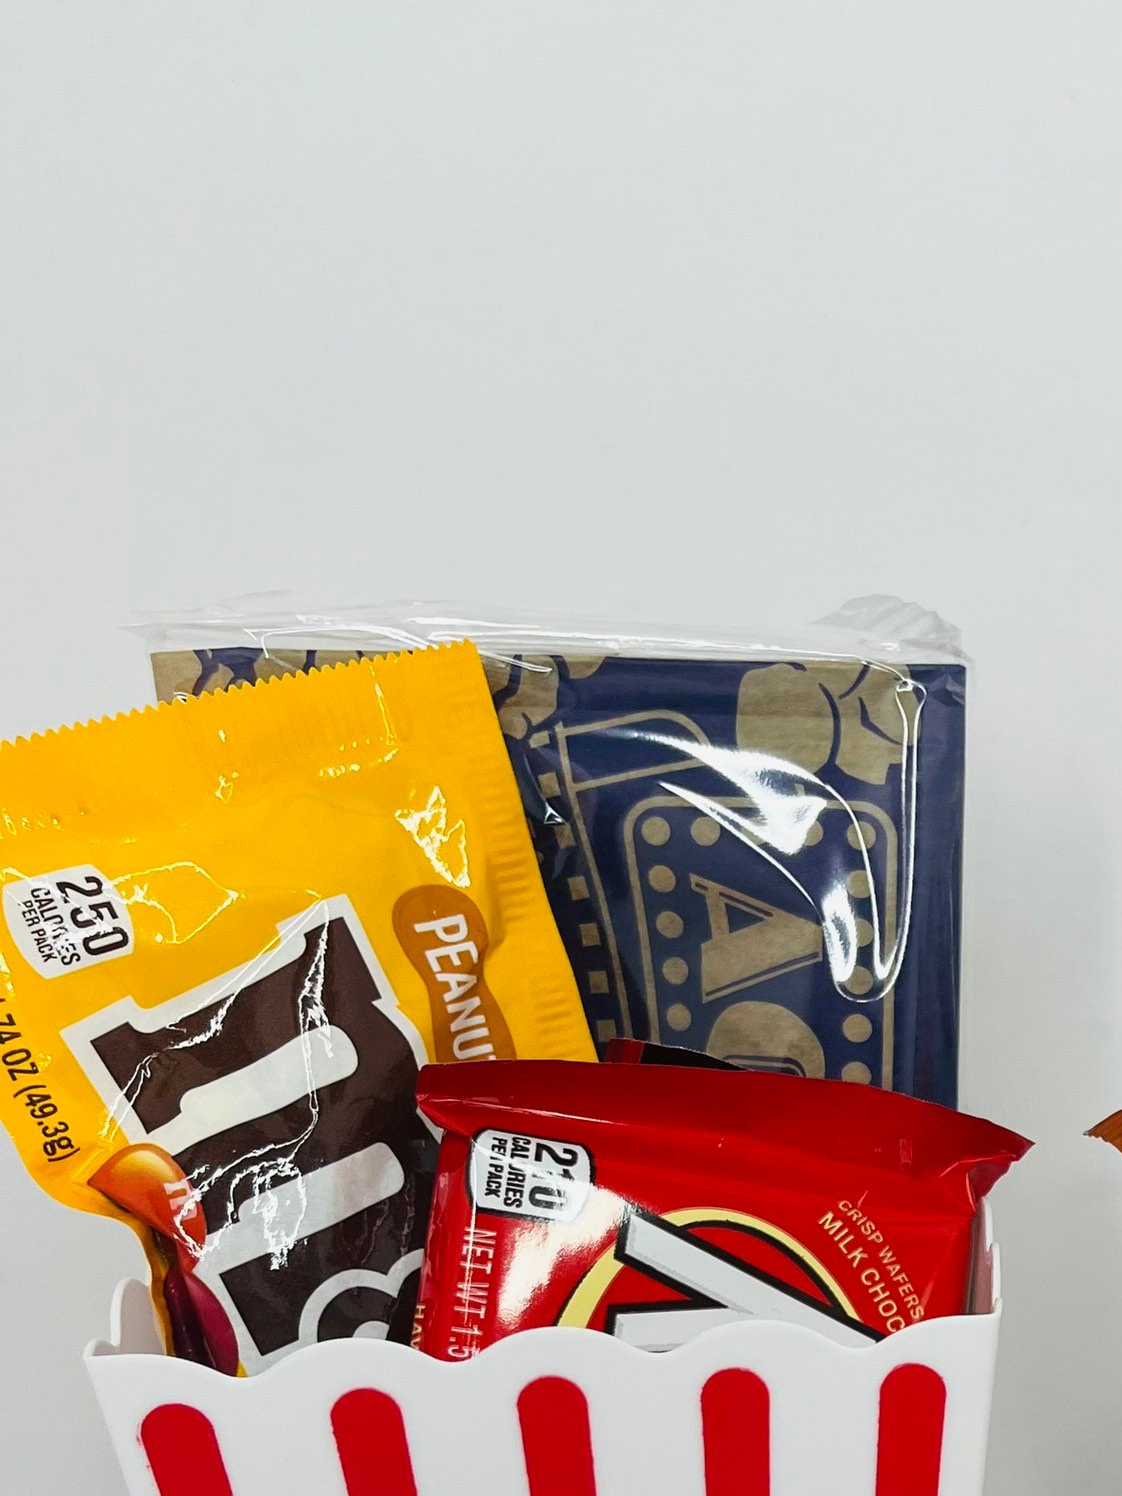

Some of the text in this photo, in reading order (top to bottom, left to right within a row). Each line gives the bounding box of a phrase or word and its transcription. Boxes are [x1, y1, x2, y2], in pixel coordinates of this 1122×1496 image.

[18, 900, 58, 963] PER PACK
[30, 887, 81, 966] CALORES
[56, 875, 129, 956] 250
[413, 913, 497, 1061] PEANU
[0, 998, 80, 1162] 74 OZ (49.3g)
[484, 1162, 505, 1198] PACK
[460, 1226, 497, 1275] NET
[818, 1211, 906, 1333] MILK CHOC
[838, 1200, 925, 1321] CRISP WAFERS
[453, 1282, 490, 1319] WT
